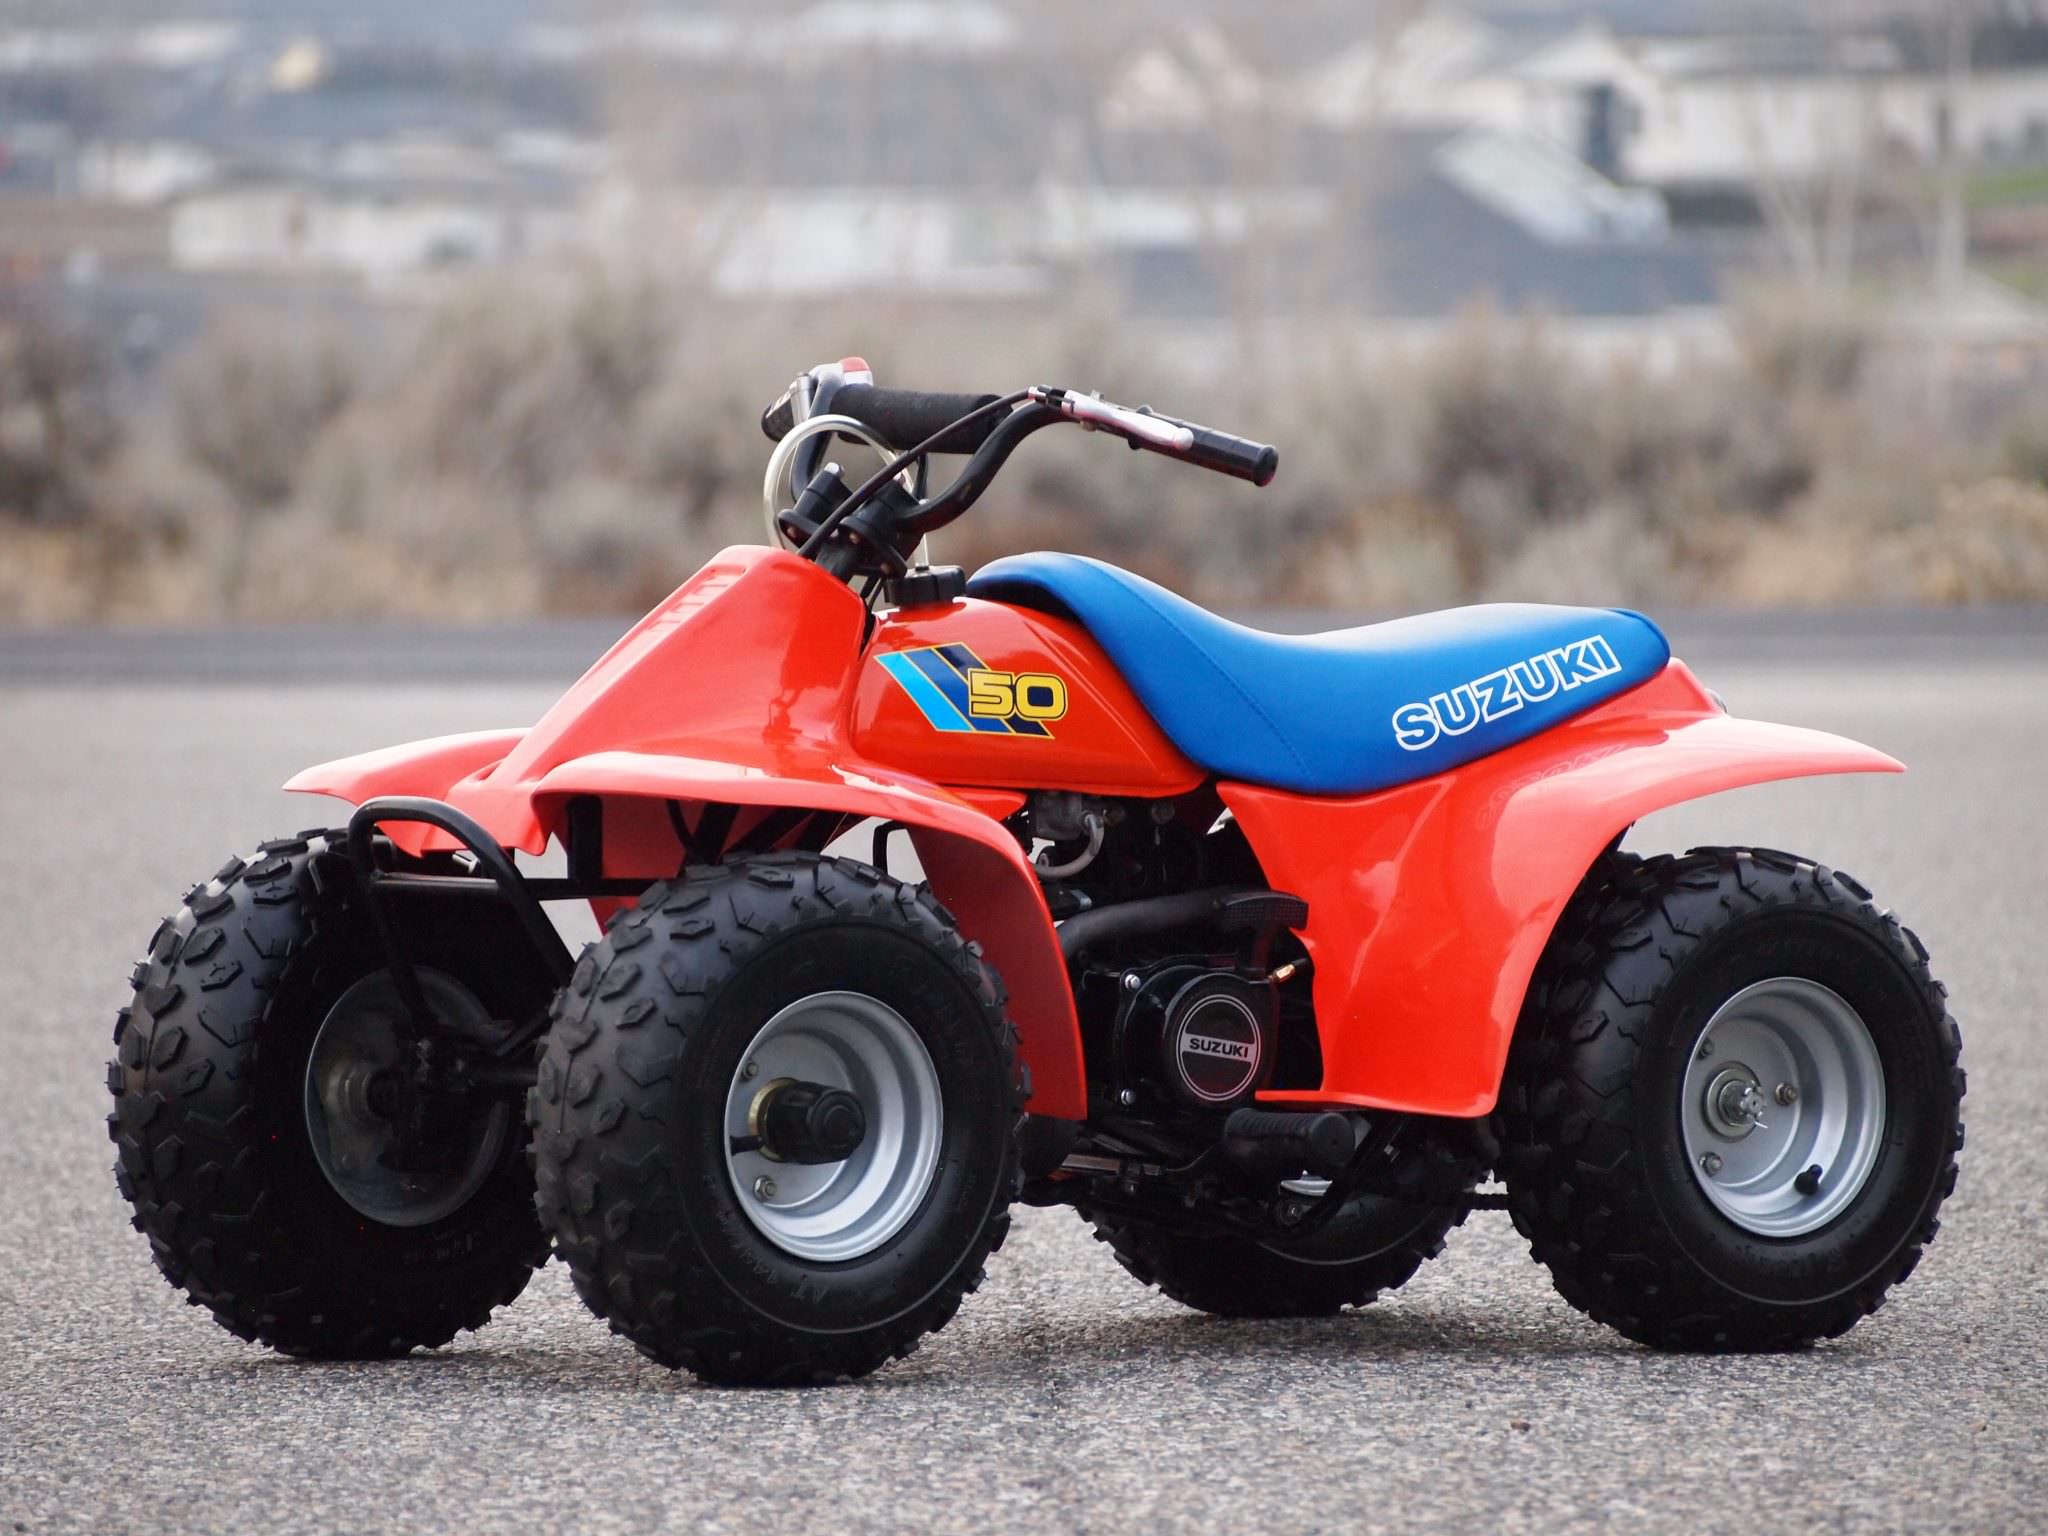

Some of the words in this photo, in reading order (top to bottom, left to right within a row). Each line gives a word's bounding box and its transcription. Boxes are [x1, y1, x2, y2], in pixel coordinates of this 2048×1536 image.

[968, 668, 1068, 721] 50
[1392, 635, 1621, 750] SUZUKI
[1189, 1037, 1249, 1058] SUZUKI
